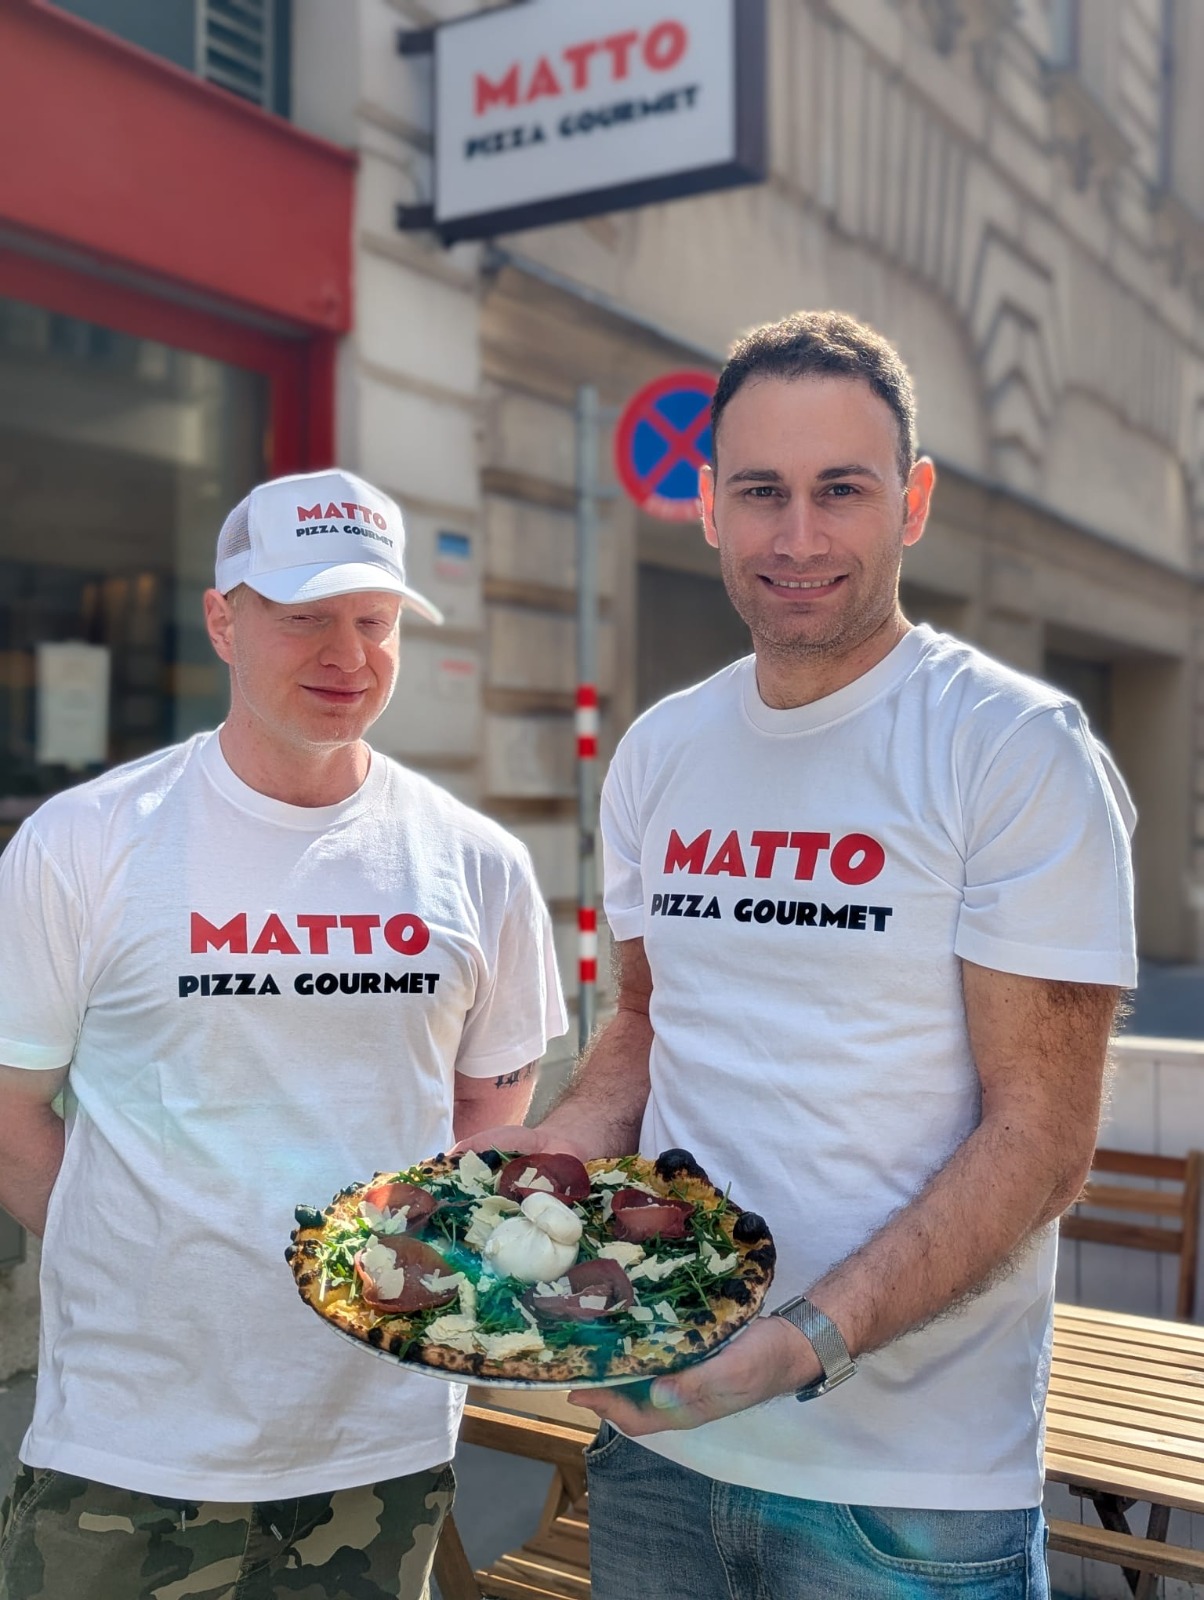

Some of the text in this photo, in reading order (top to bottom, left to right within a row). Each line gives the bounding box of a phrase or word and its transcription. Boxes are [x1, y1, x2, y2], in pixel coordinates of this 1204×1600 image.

[473, 19, 688, 117] MATTO
[464, 84, 700, 159] PIZZA GOURMET
[296, 525, 393, 547] PIZZA GOURMET
[297, 502, 387, 530] MATTO
[663, 829, 885, 886] MATTO
[651, 893, 893, 932] PIZZA GOURMET
[191, 912, 430, 955] MATTO
[178, 972, 440, 998] PIZZA GOURMET
